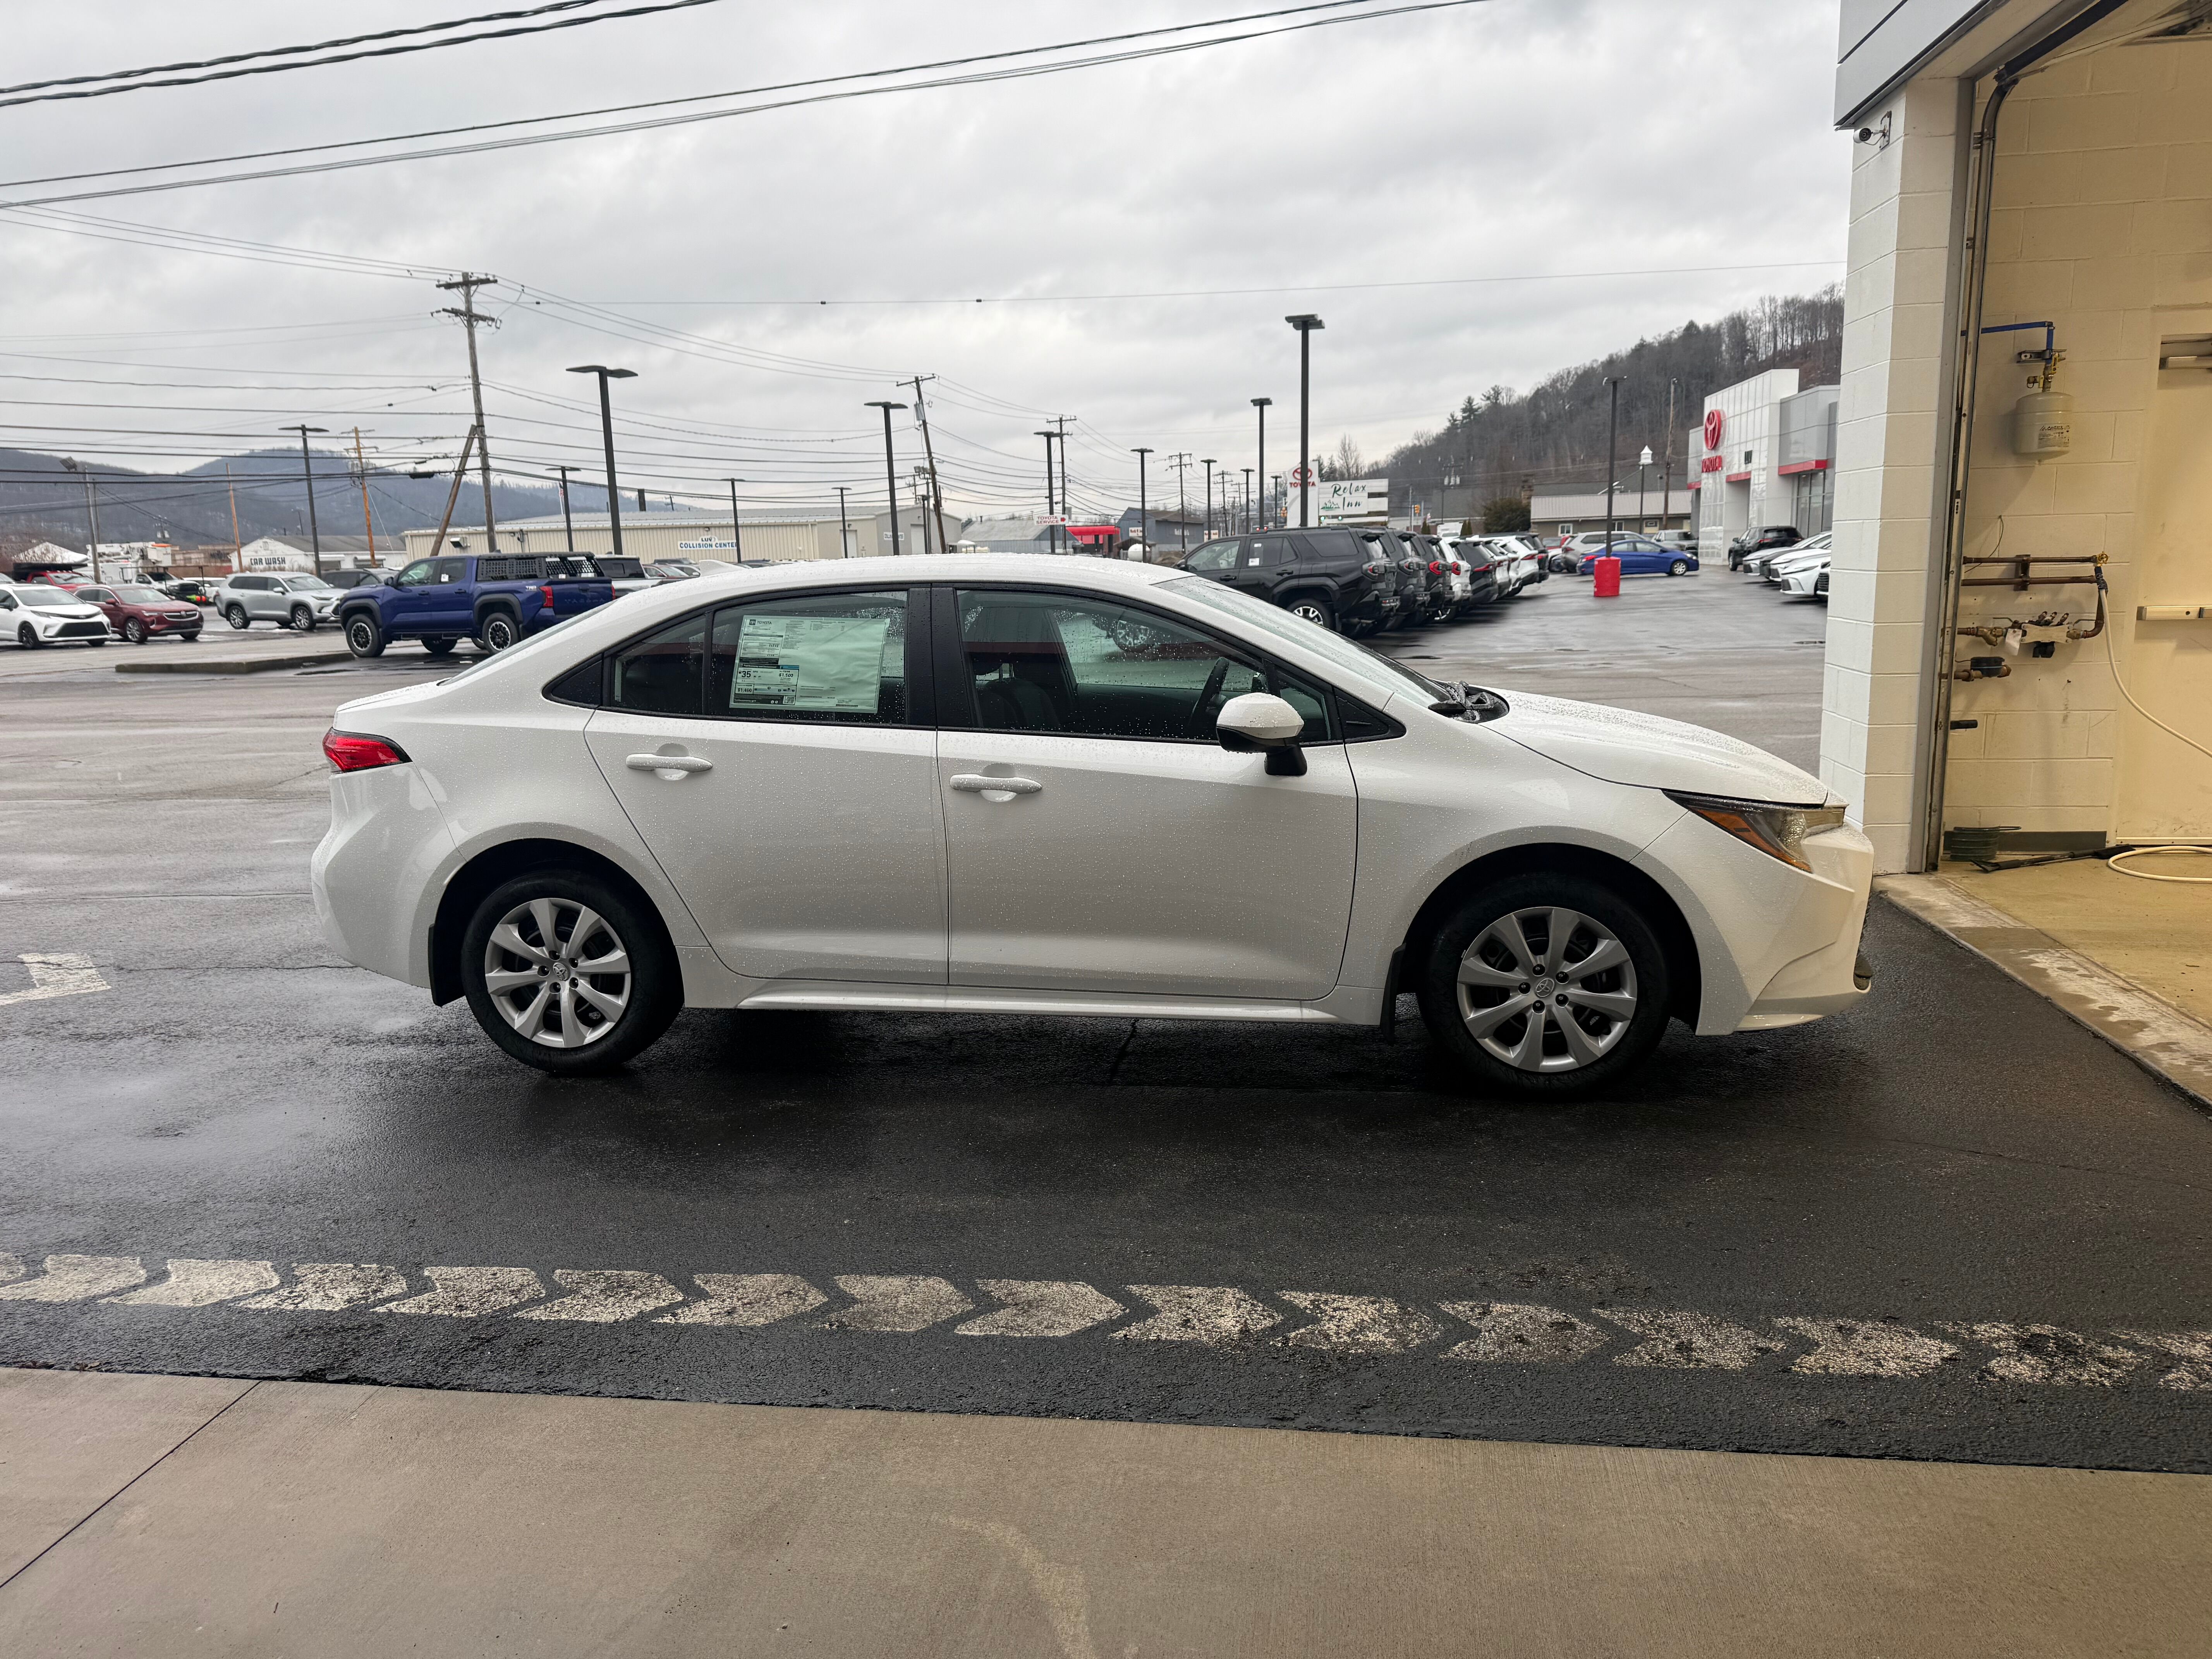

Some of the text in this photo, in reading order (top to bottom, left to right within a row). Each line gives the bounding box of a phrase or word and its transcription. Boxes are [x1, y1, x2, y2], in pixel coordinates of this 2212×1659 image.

[1331, 483, 1366, 498] Relax
[1343, 497, 1362, 511] Inn
[264, 557, 286, 565] WASH
